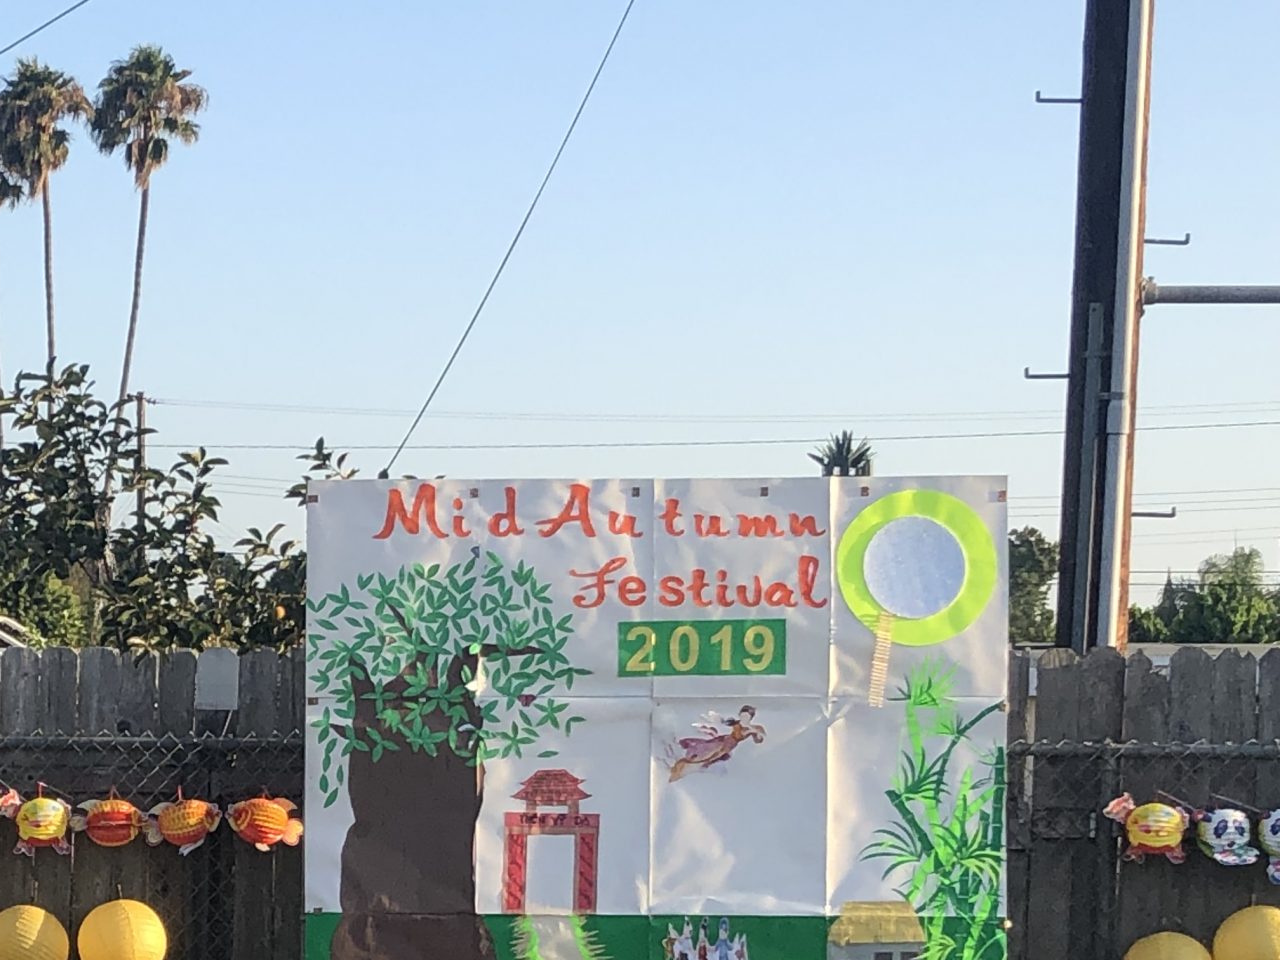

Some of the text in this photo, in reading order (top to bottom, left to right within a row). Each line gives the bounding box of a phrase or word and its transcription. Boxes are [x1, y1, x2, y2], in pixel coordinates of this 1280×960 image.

[372, 483, 827, 540] Mid Autumn
[568, 555, 828, 609] Festival
[625, 624, 775, 672] 2019
